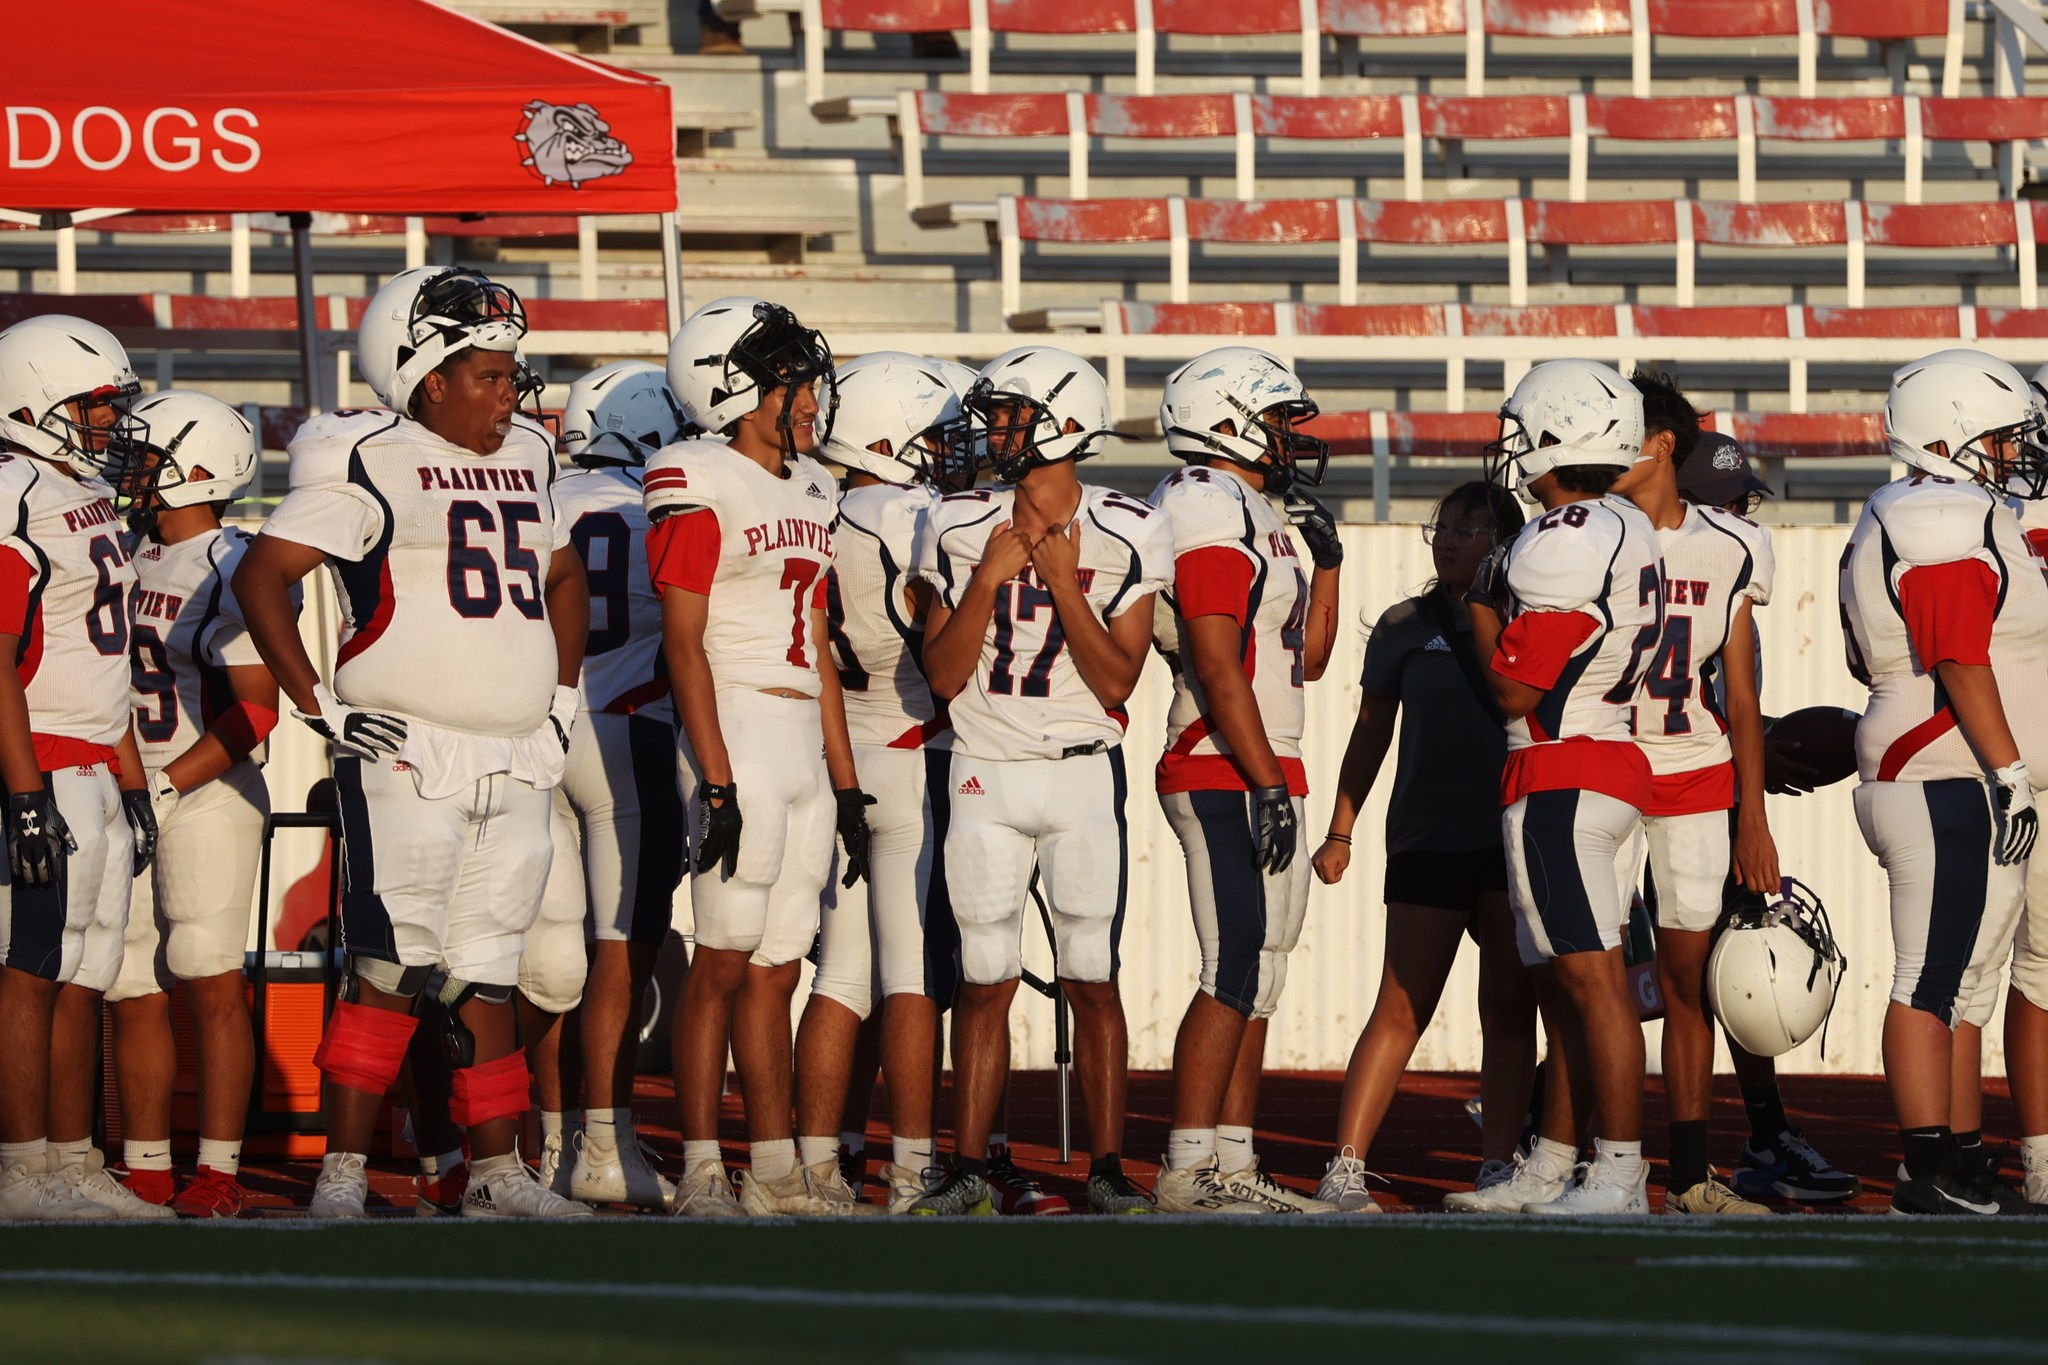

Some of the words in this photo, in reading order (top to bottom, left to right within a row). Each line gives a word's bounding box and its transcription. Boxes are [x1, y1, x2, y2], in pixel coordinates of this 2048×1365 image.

[6, 106, 262, 172] DOGS
[446, 499, 545, 621] 65
[1537, 504, 1590, 534] 28
[779, 557, 820, 669] 7
[986, 581, 1066, 698] 17
[1630, 614, 1694, 736] 4
[958, 787, 985, 796] adidas
[466, 1196, 497, 1211] adidas
